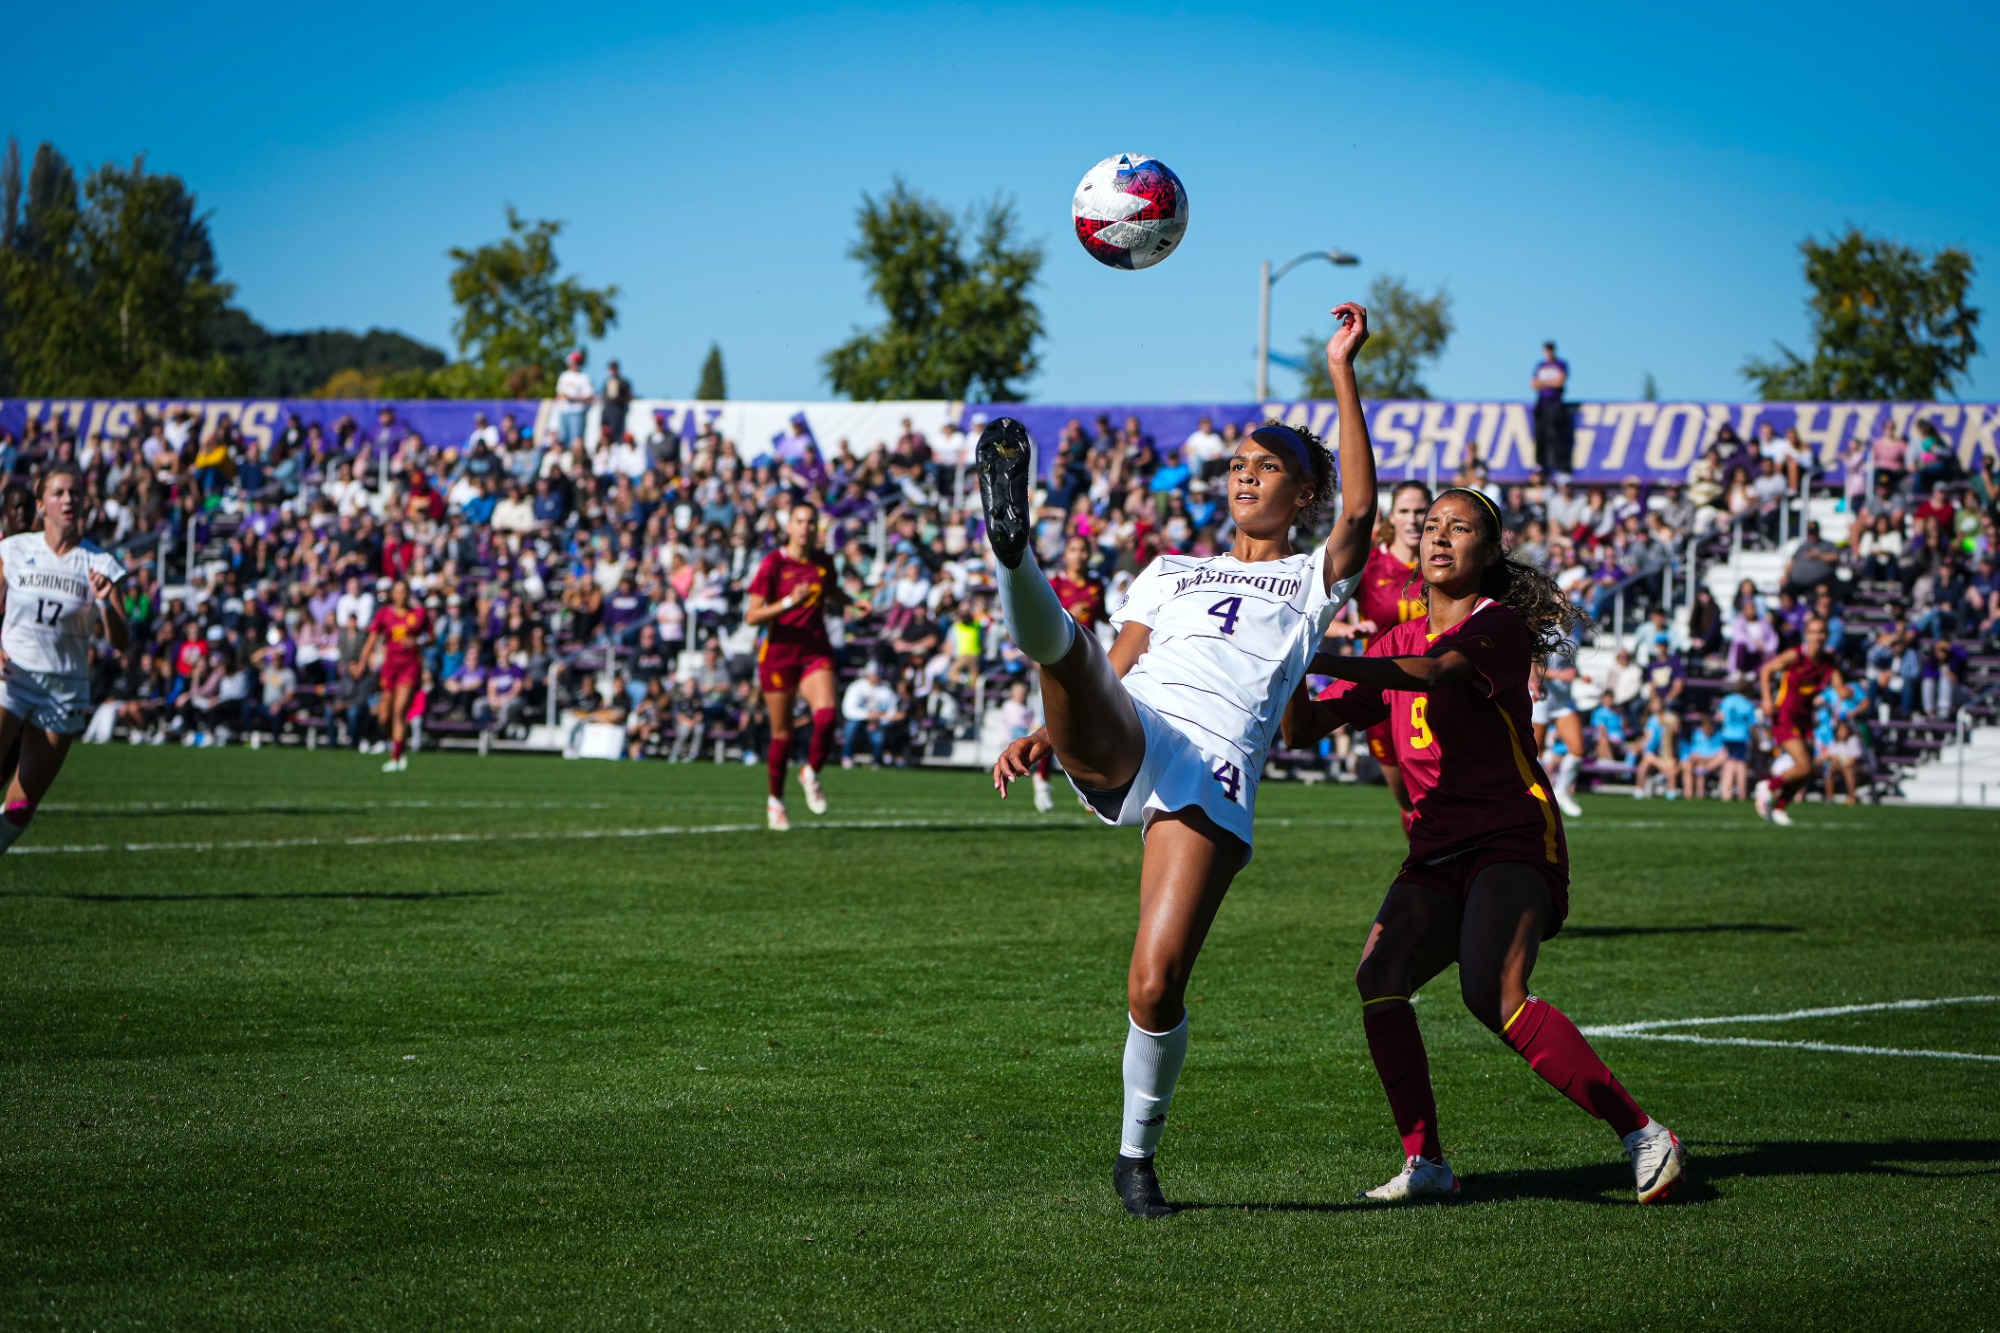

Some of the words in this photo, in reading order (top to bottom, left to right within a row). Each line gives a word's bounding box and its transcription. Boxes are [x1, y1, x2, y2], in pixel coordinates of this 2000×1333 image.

[1261, 402, 1763, 470] WSHINTON
[1173, 569, 1302, 600] WASHINGTON
[36, 597, 63, 627] 17
[1208, 596, 1243, 635] 4
[1410, 697, 1433, 749] 9
[1213, 760, 1240, 803] 4
